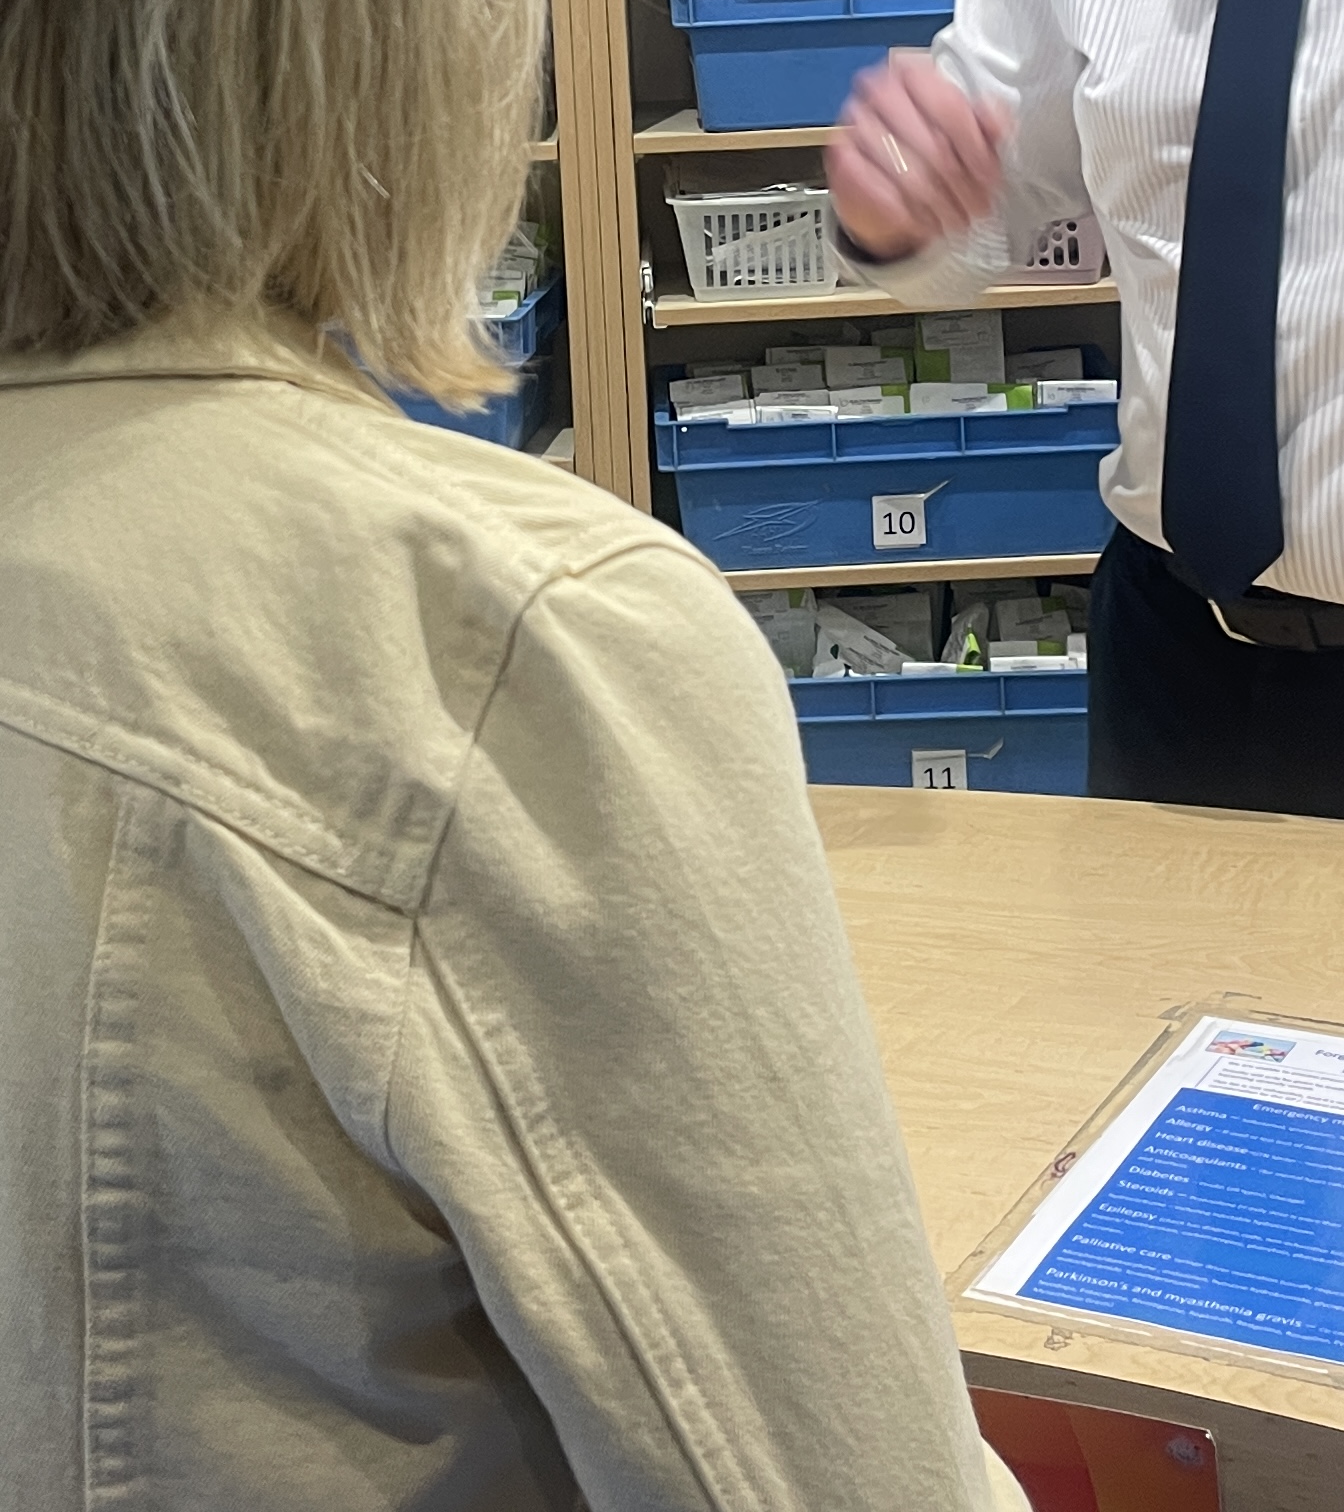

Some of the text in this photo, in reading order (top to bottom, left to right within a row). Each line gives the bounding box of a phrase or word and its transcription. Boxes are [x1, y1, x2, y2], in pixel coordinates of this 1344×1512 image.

[883, 511, 916, 535] 10
[923, 766, 956, 790] 11
[1175, 1104, 1227, 1120] Asthma
[1252, 1103, 1330, 1124] Emergency
[1165, 1117, 1213, 1133] Allergy
[1155, 1131, 1249, 1155] Heart disease
[1143, 1145, 1248, 1171] Anticoagulants
[1128, 1165, 1191, 1184] Diabetes
[1117, 1180, 1174, 1197] Steroids
[1098, 1202, 1158, 1221] Epilepsy
[1071, 1234, 1172, 1260] Palliative care
[1045, 1266, 1303, 1329] Parkinson's and myasthenia gravis
